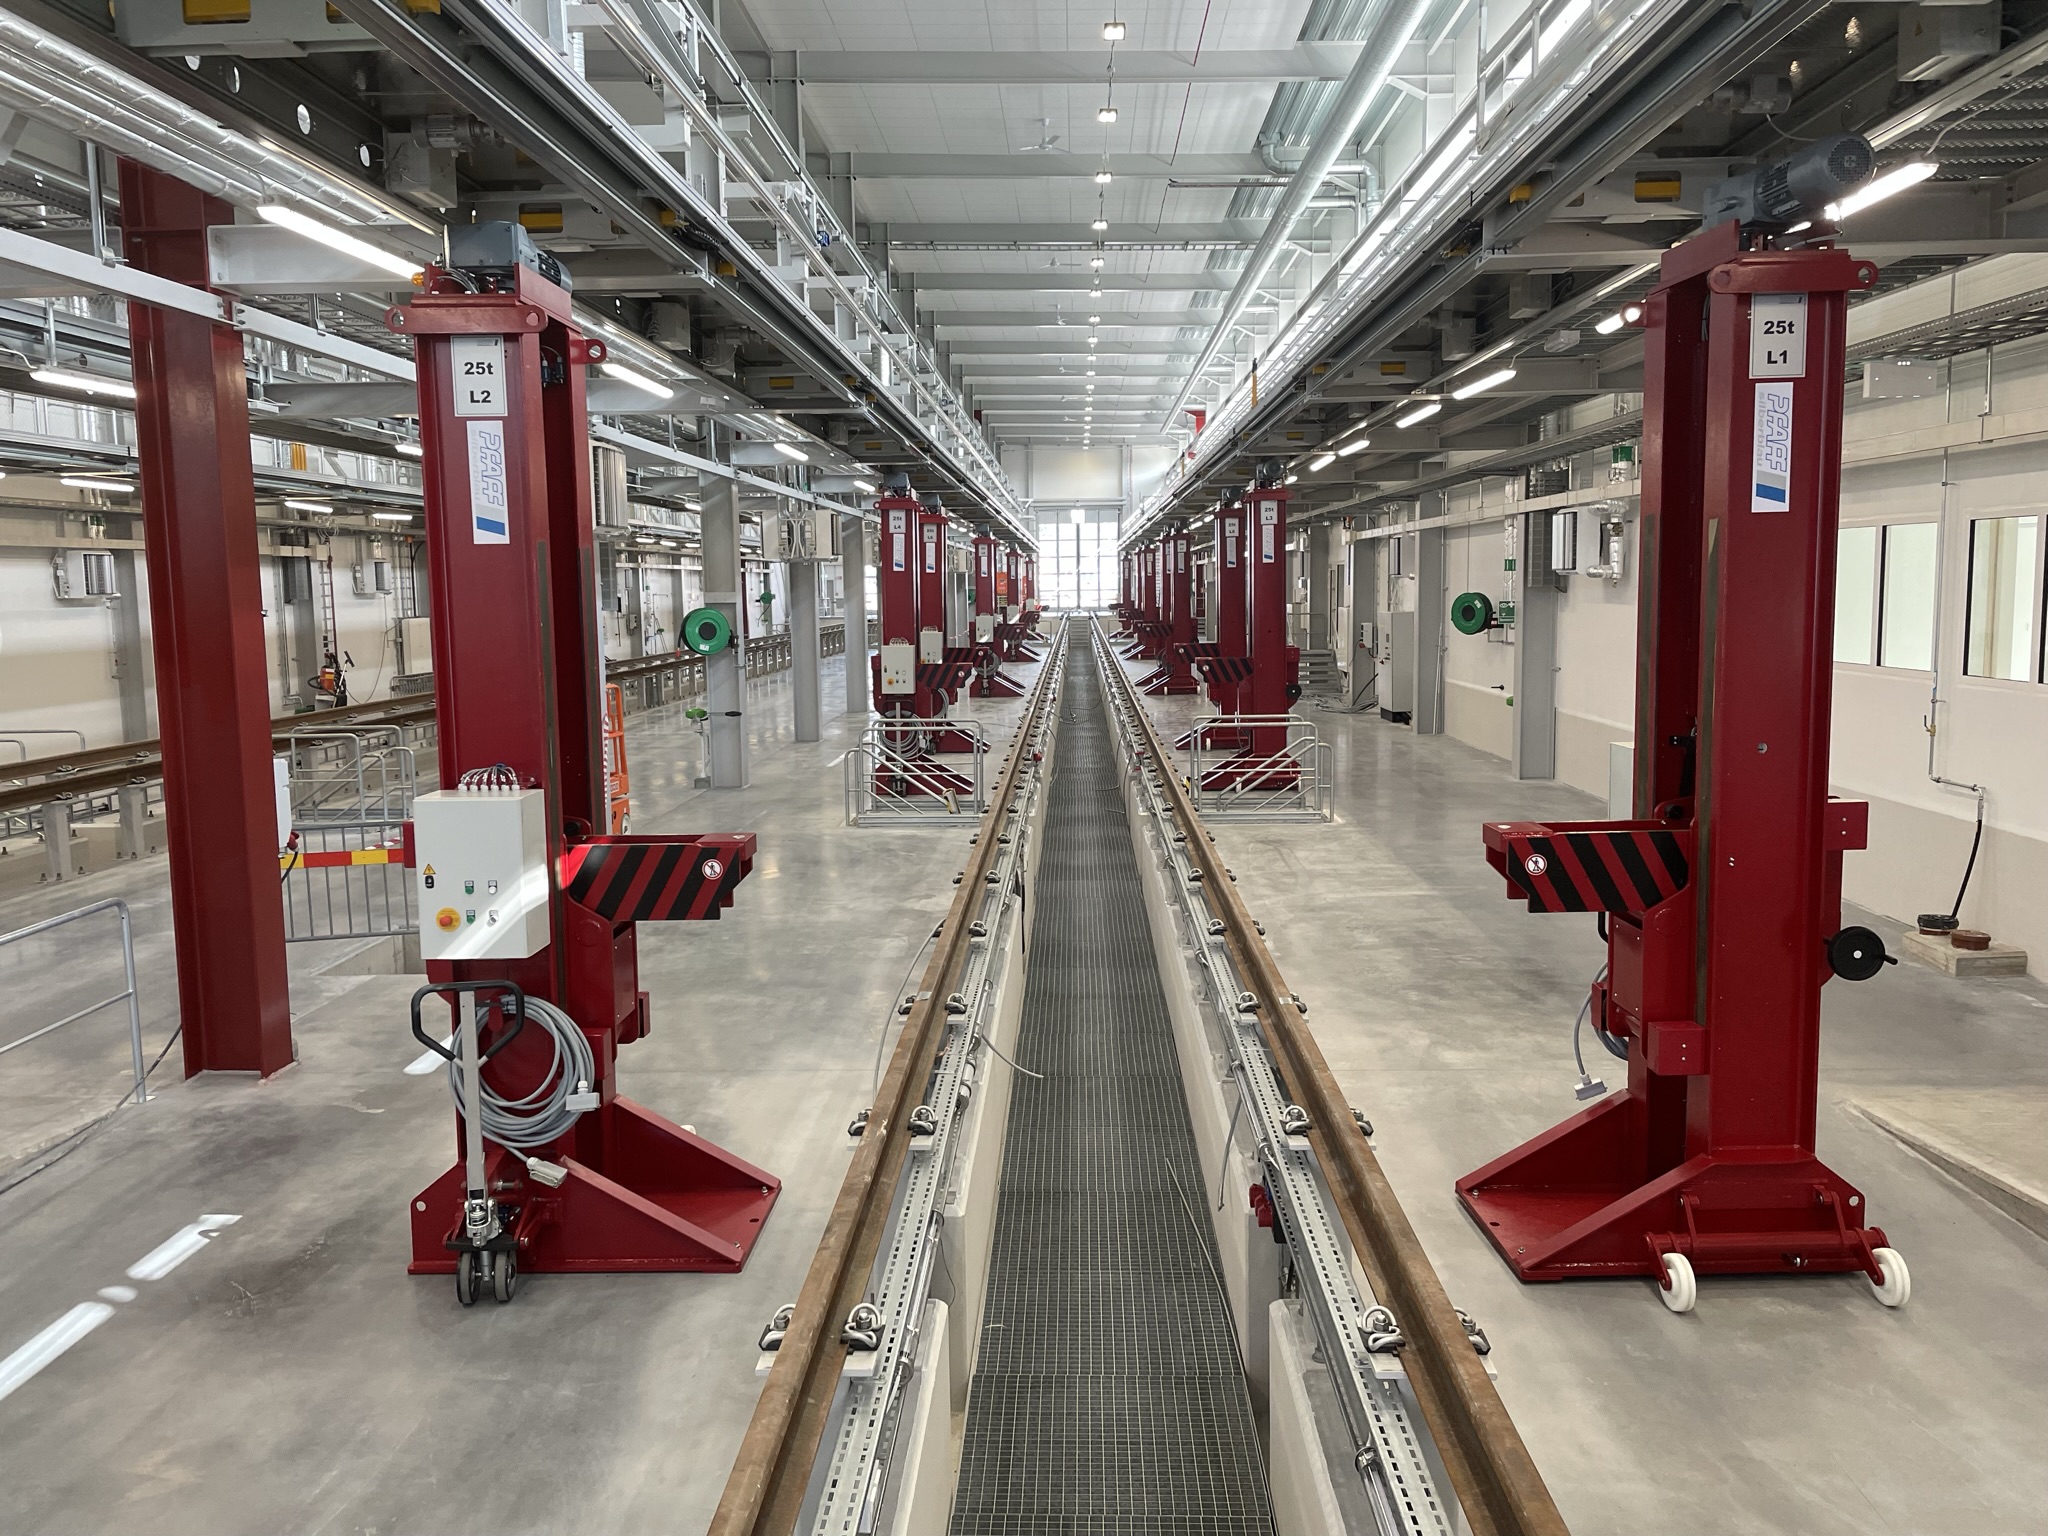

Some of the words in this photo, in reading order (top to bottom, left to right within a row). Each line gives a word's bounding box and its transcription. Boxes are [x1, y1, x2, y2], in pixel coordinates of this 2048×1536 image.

[1763, 320, 1795, 335] 25t
[1767, 349, 1788, 365] L1
[464, 361, 494, 375] 25t
[469, 390, 492, 404] L2
[1756, 391, 1767, 467] silberblau
[1765, 393, 1790, 473] PFAFF
[478, 430, 505, 507] PFAFF
